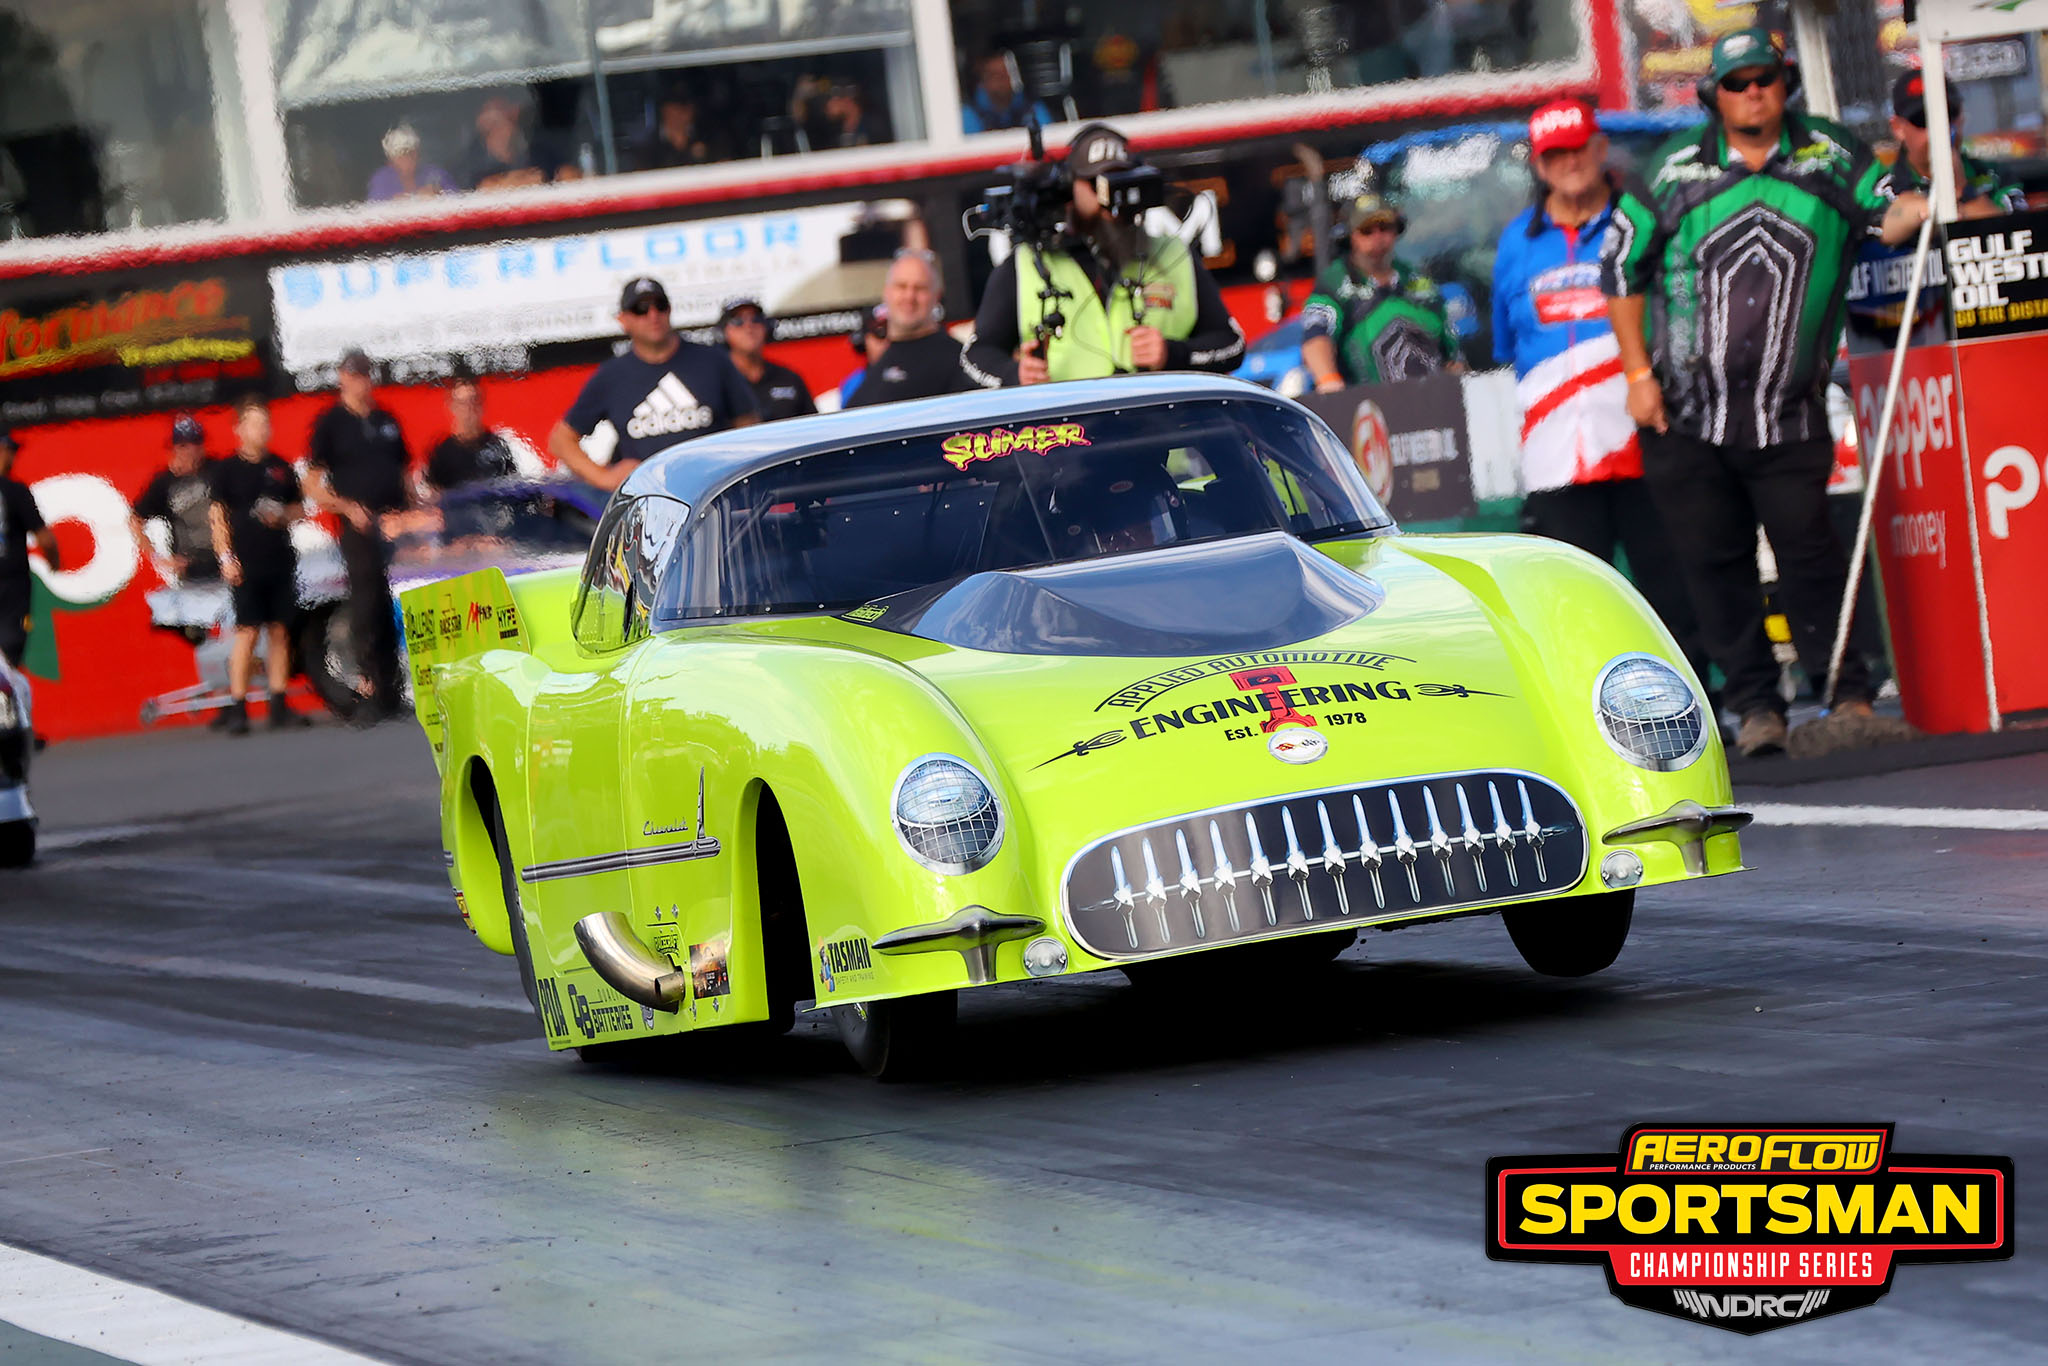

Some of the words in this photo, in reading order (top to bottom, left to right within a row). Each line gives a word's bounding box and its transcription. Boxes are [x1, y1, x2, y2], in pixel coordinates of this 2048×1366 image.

[1946, 229, 2033, 265] GULF
[1952, 282, 2010, 311] OIL
[1978, 304, 2007, 326] THE
[627, 404, 713, 440] adidas
[1891, 510, 1947, 569] money
[1108, 667, 1205, 708] APPLIED
[1208, 651, 1395, 672] AUTOMOTIVE
[1130, 680, 1412, 740] ENGINEERING
[1224, 726, 1259, 741] Est.
[1324, 712, 1367, 726] 1978
[827, 937, 872, 973] TASMAN
[591, 1004, 633, 1033] BATTERIES
